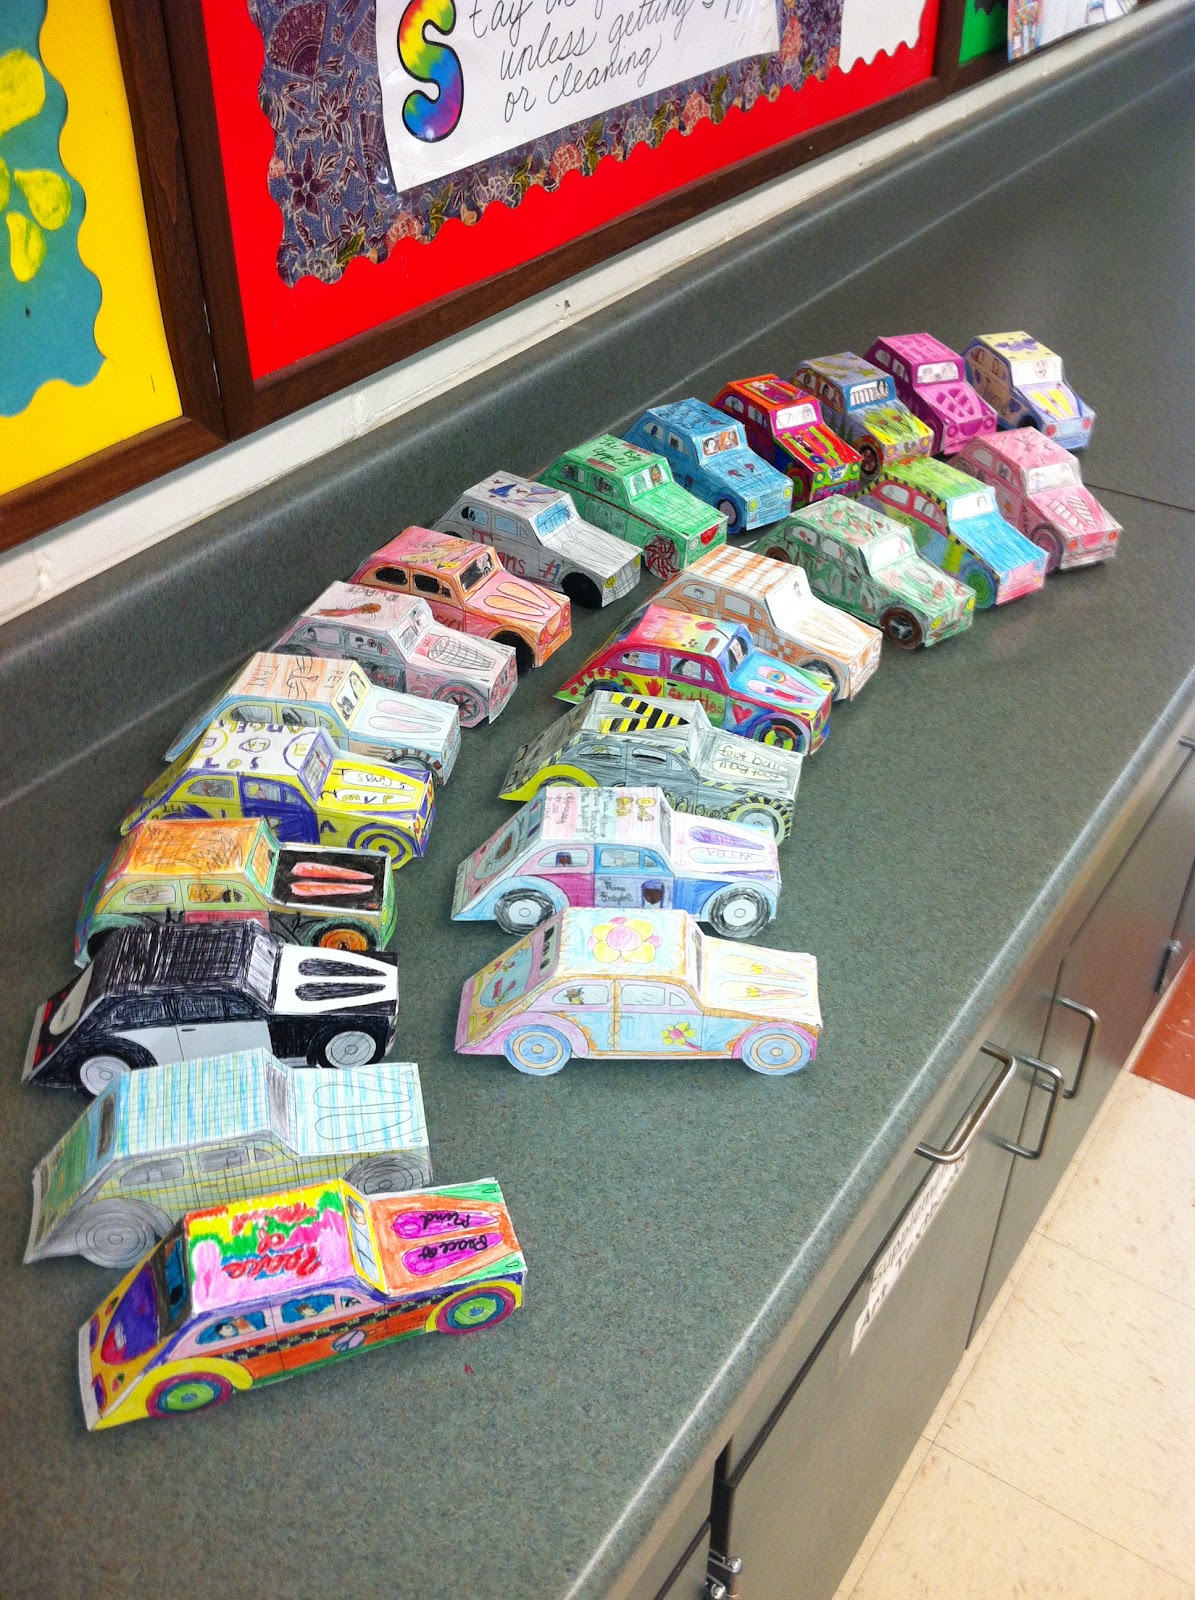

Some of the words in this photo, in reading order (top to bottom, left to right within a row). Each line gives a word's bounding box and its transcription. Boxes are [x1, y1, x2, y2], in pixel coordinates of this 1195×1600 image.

[499, 22, 598, 81] unless
[608, 0, 696, 64] getting
[397, 0, 464, 142] S
[504, 85, 538, 123] or
[547, 34, 664, 105] cleaning
[719, 744, 748, 761] foot
[419, 1210, 472, 1230] Mind
[257, 1228, 284, 1252] of
[418, 1244, 438, 1260] of
[439, 1234, 489, 1257] Peace
[220, 1248, 321, 1282] Peace
[857, 1283, 887, 1339] Art
